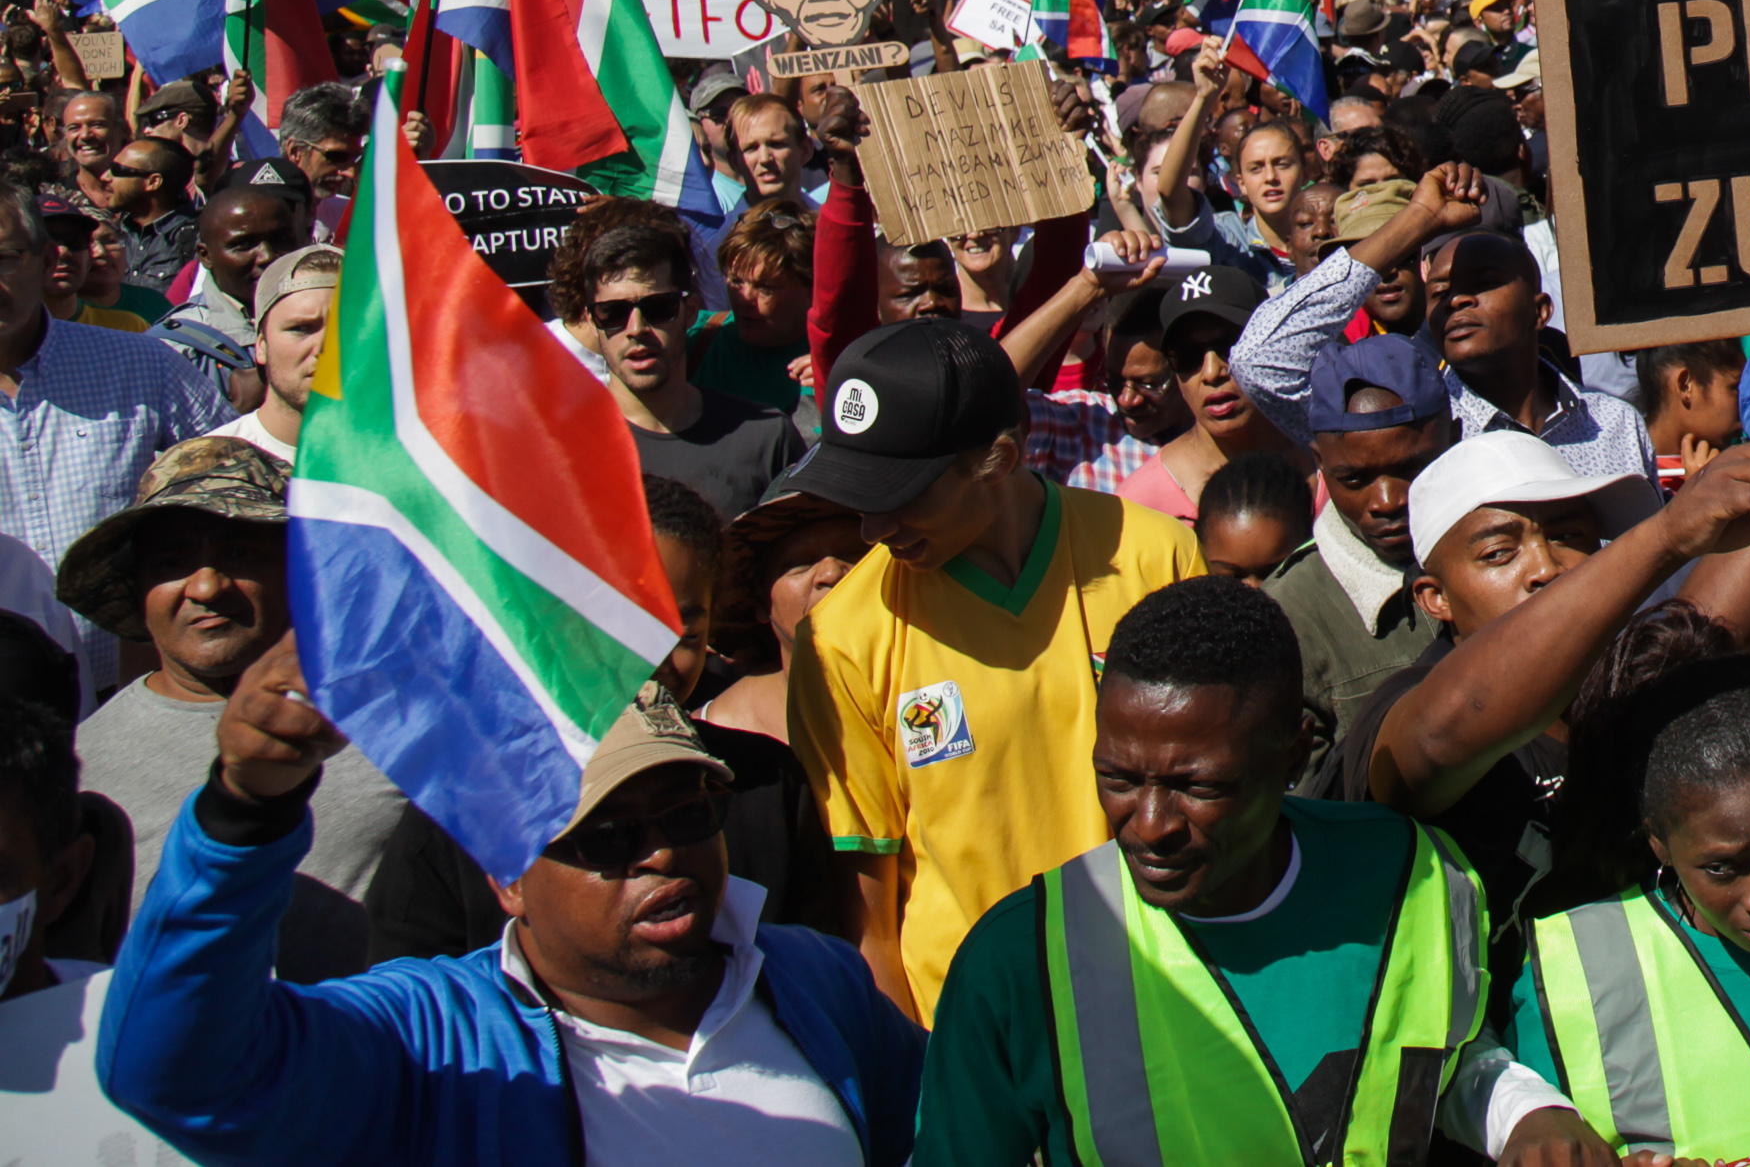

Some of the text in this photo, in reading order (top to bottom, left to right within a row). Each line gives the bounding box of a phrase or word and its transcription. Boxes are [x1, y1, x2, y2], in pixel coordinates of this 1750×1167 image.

[990, 2, 1023, 25] FREE
[989, 19, 1006, 34] SA
[82, 47, 113, 60] DONE
[903, 190, 935, 213] WE
[942, 180, 991, 207] NEED
[1003, 171, 1048, 195] NEW
[471, 189, 510, 211] TO
[463, 225, 572, 255] APTUR
[907, 741, 933, 752] AFRICA
[918, 746, 935, 756] 2010
[947, 739, 971, 752] FIFA
